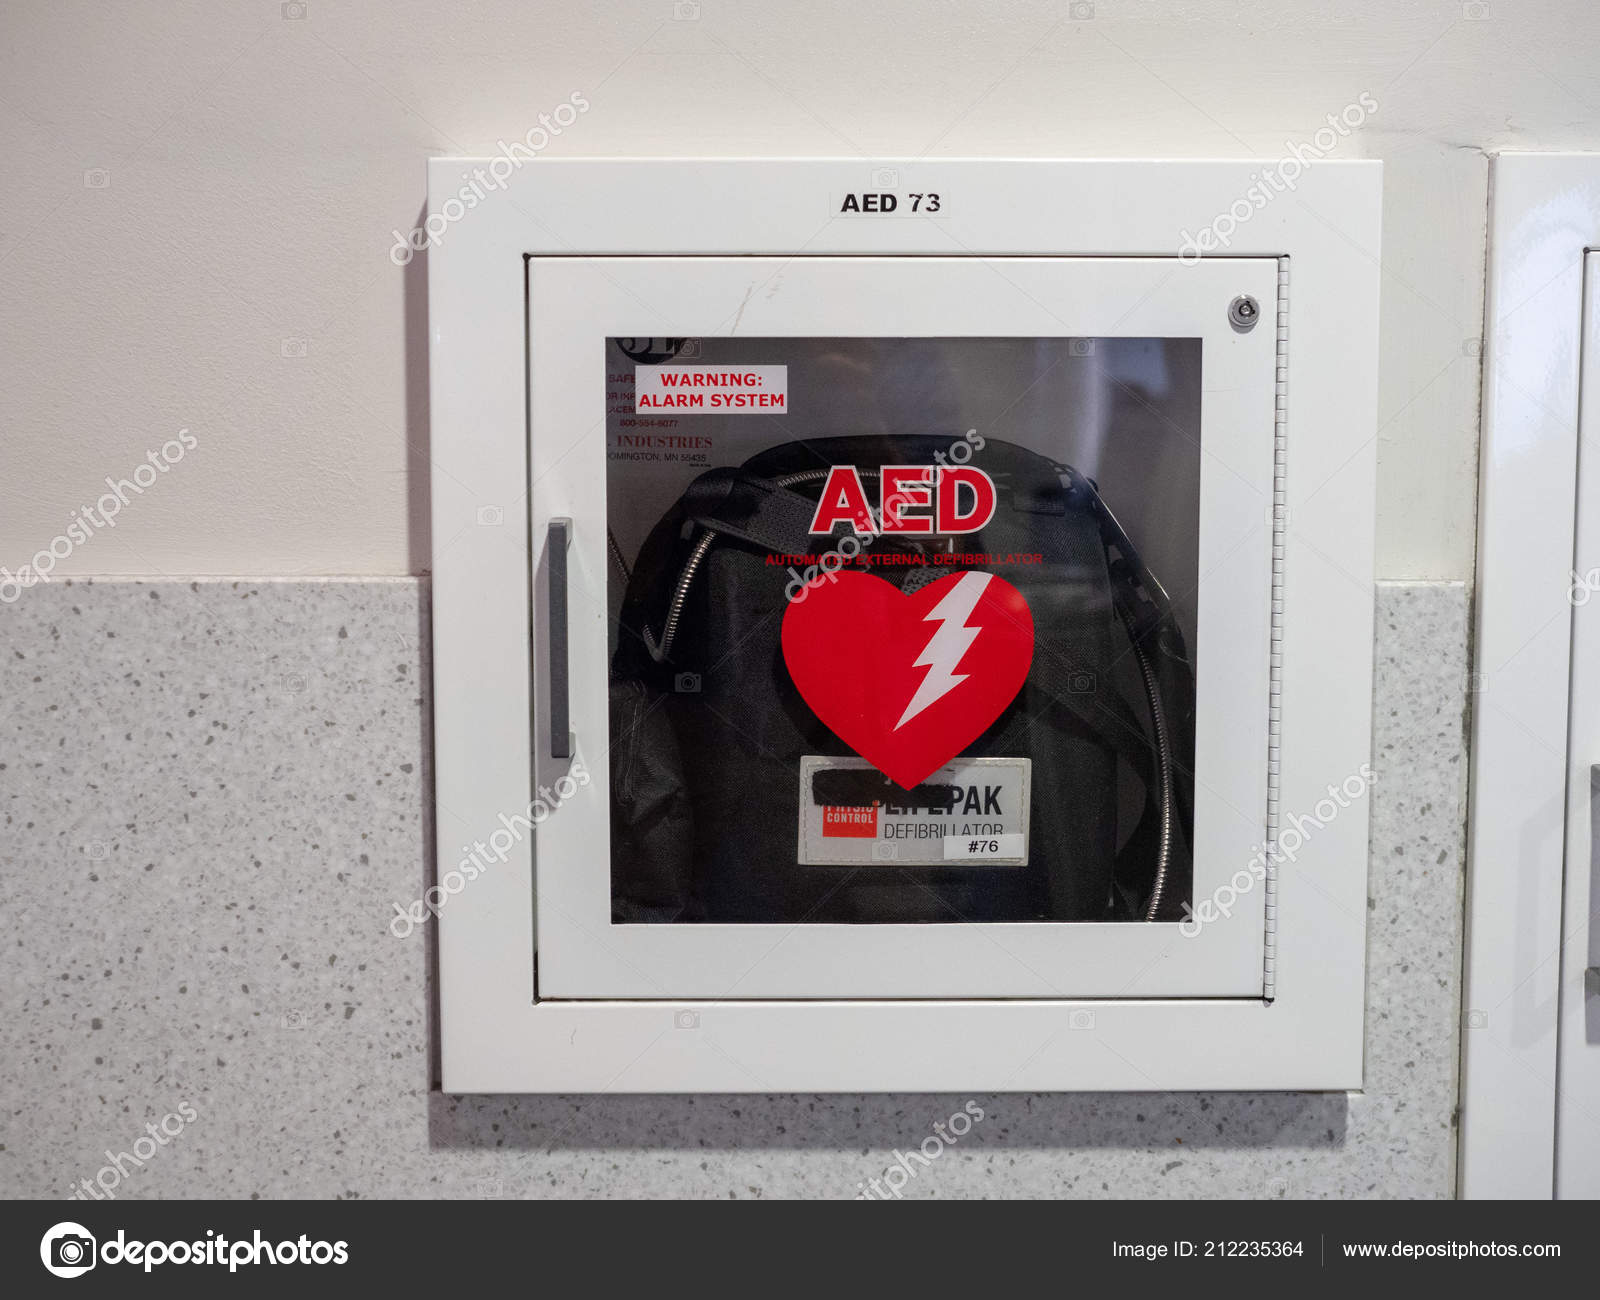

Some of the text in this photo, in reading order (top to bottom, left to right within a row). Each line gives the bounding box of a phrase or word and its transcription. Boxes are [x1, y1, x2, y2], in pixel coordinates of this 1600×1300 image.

[841, 193, 941, 212] AED 73
[660, 373, 763, 387] WARNING:
[639, 393, 785, 407] ALARM SYSTEM
[617, 434, 713, 449] INDUSTRIES
[664, 453, 679, 462] MN
[808, 465, 997, 534] AED
[765, 553, 1043, 566] AUTOMATED EXTERNAL DEFIBRILLATOR
[826, 813, 874, 824] CONTROL
[968, 840, 999, 853] #76
